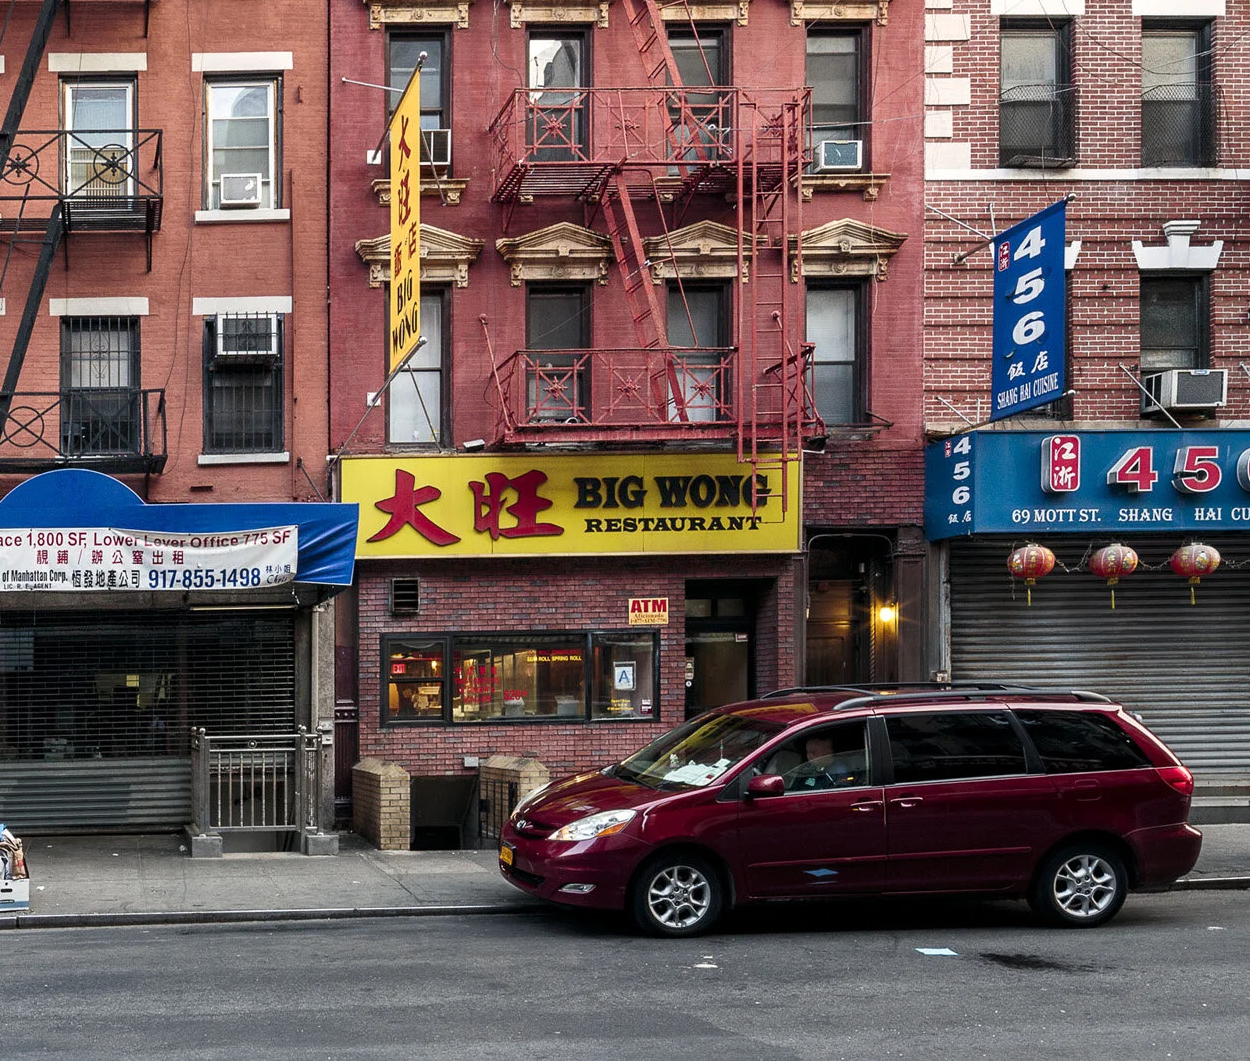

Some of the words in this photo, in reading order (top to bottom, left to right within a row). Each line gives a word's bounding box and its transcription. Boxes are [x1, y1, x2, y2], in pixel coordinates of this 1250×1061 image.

[397, 269, 413, 316] BIG
[1012, 225, 1046, 345] 456
[392, 301, 418, 352] WONG
[1007, 350, 1049, 381] 飯店
[997, 387, 1018, 410] SHANG
[1019, 383, 1032, 402] HAI
[1033, 372, 1059, 396] CUISINE
[952, 436, 971, 505] 456
[1053, 437, 1077, 489] 江浙
[1108, 446, 1250, 493] 45
[366, 469, 565, 547] 大旺
[574, 476, 648, 509] BIG
[654, 474, 772, 509] WONG
[584, 516, 762, 533] RESTAURANT
[1012, 510, 1030, 524] 69
[1034, 509, 1077, 523] MOTT
[1079, 509, 1101, 522] ST.
[1118, 508, 1172, 522] SHANG
[1194, 507, 1222, 521] HAI
[27, 532, 63, 549] 1,800
[93, 532, 139, 547] Lower
[190, 535, 239, 548] Office
[243, 532, 268, 546] 775
[272, 530, 291, 545] SF
[2, 569, 10, 582] of
[11, 569, 47, 582] Manhattan
[49, 569, 68, 584] Corp.
[149, 567, 261, 589] 917-855-1498
[631, 599, 667, 613] ATM
[618, 669, 630, 683] A
